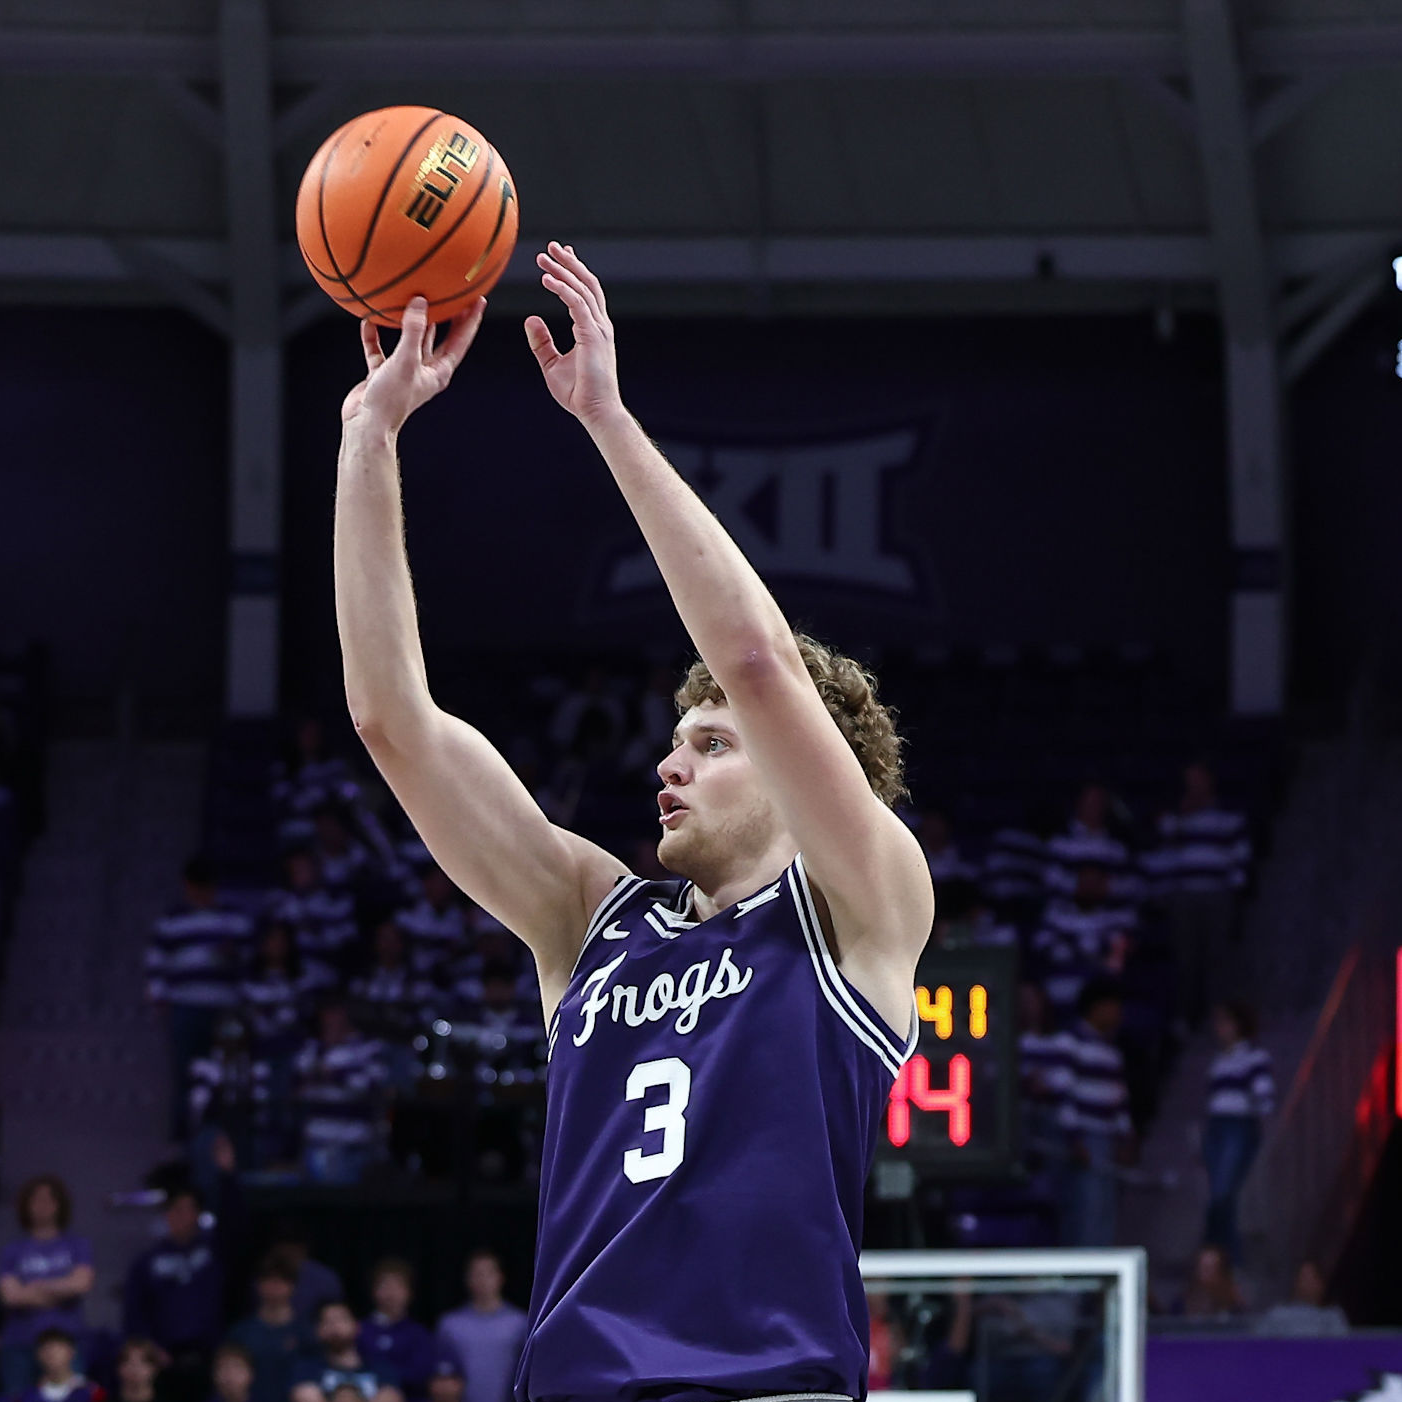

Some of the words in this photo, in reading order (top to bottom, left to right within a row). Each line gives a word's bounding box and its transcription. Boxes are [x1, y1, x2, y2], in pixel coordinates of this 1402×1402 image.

[404, 130, 482, 232] ELITE
[571, 947, 753, 1047] Frogs
[915, 985, 987, 1039] 41
[623, 1056, 692, 1184] 3
[888, 1054, 971, 1147] 14
